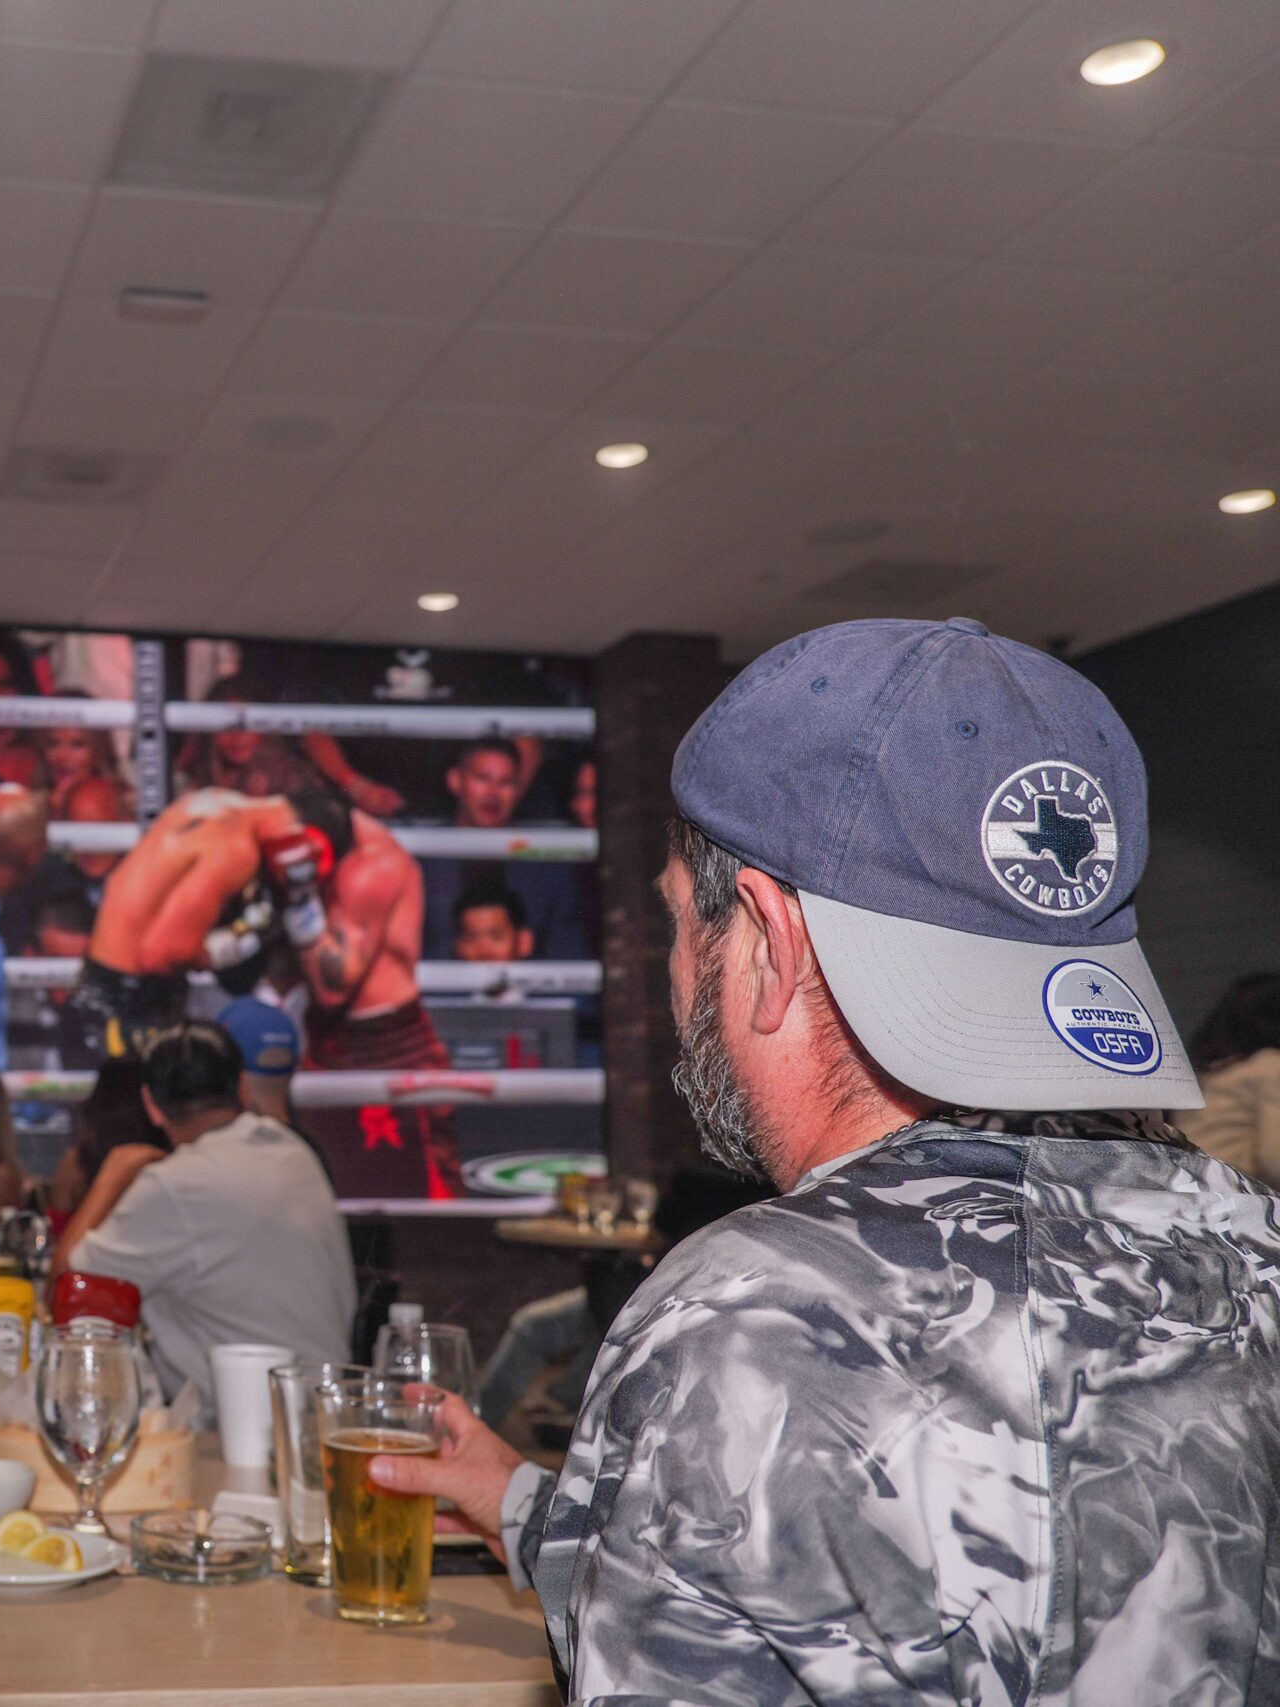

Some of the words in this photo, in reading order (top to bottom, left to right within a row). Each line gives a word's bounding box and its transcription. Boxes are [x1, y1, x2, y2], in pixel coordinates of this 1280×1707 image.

[1001, 771, 1103, 816] DALLAS
[1004, 863, 1110, 908] COWBOYS
[1071, 1008, 1140, 1025] COWBOYS
[1112, 1023, 1149, 1031] HEADWEAR
[1093, 1032, 1145, 1056] OSFA
